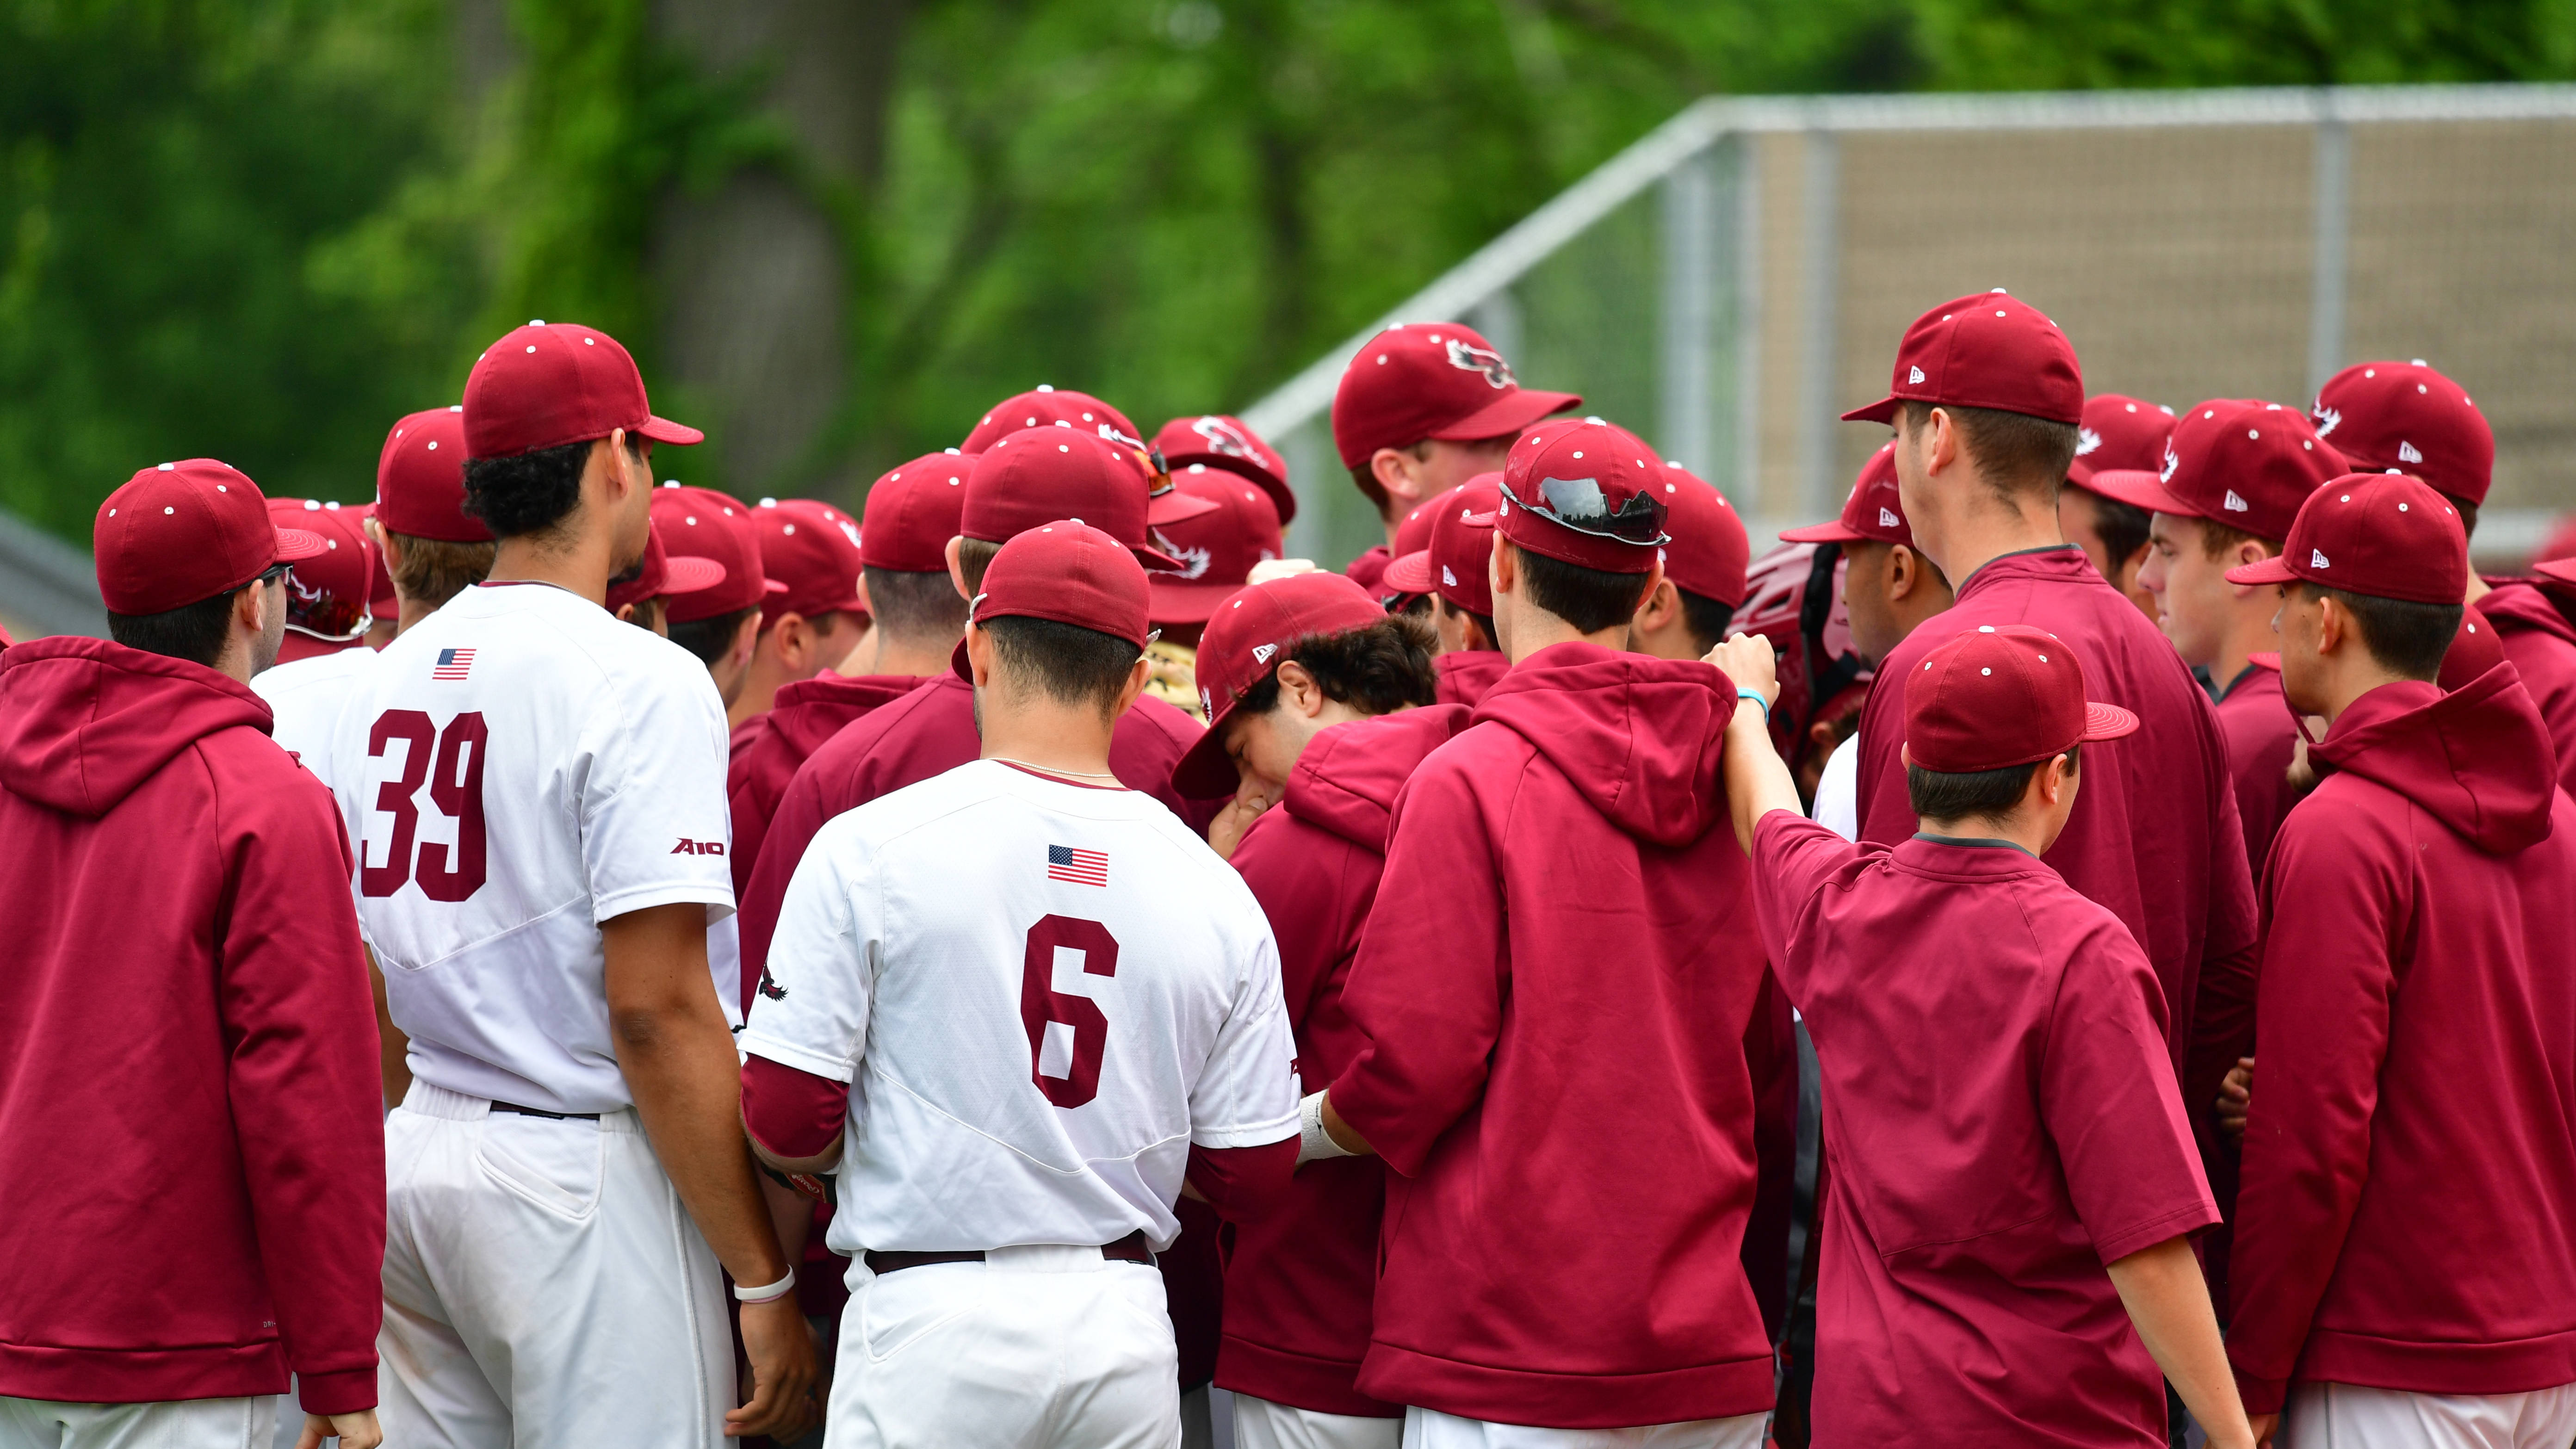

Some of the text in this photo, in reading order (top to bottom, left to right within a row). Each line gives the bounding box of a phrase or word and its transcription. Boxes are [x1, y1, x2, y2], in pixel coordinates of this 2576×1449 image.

[361, 709, 488, 902] 39
[670, 837, 724, 856] A10
[1021, 914, 1119, 1109] 6
